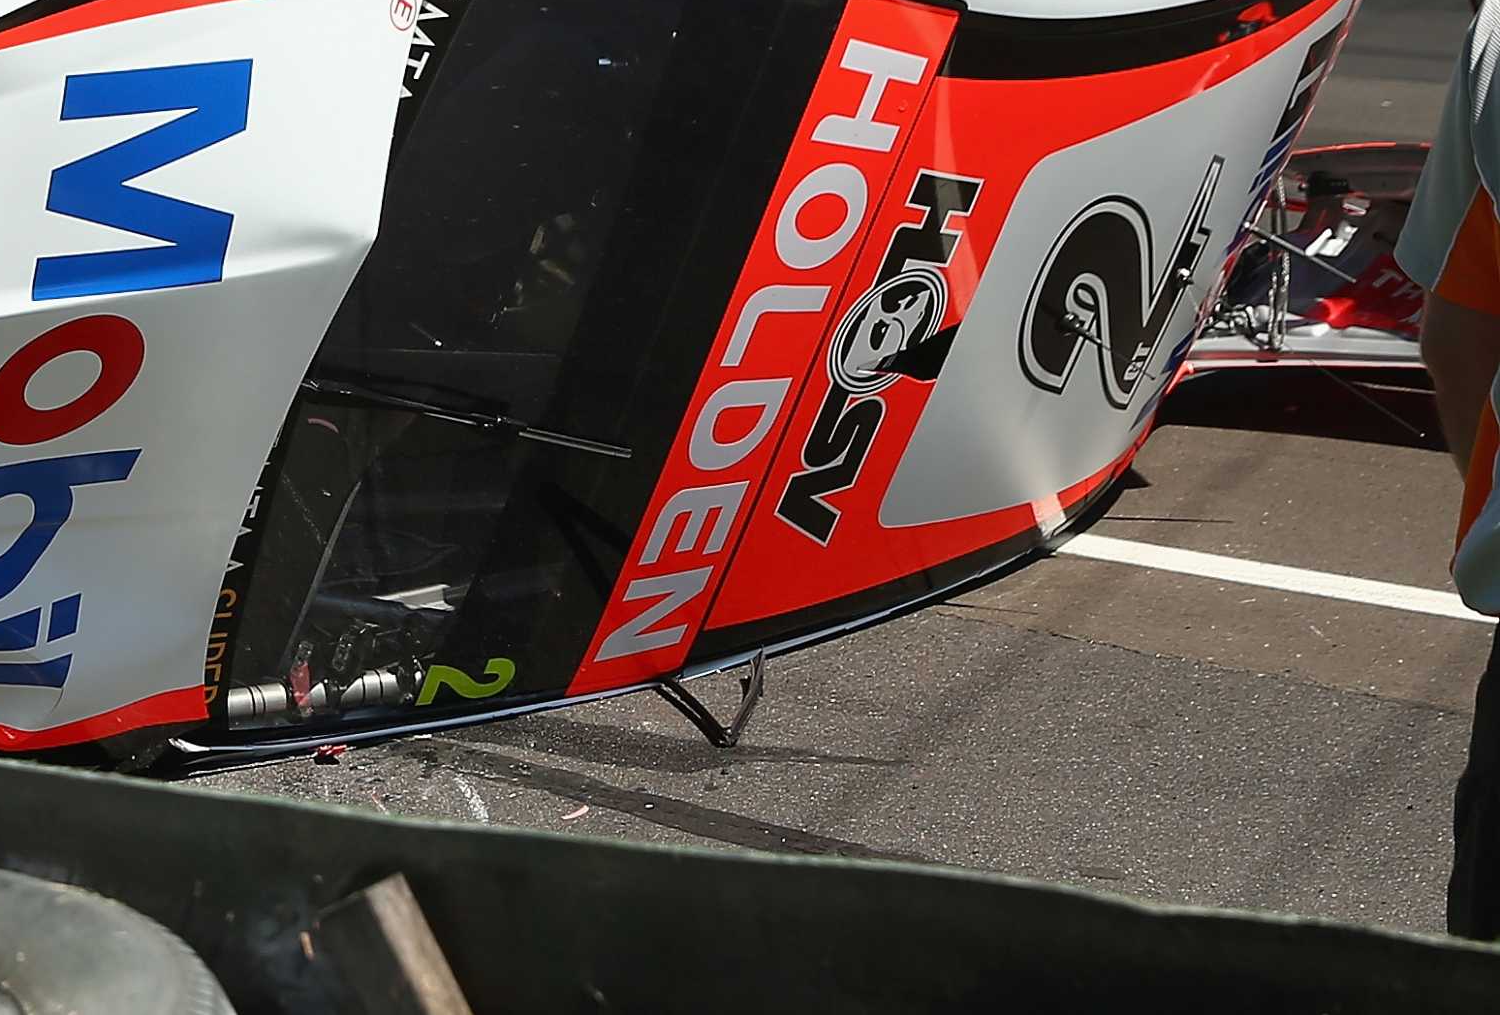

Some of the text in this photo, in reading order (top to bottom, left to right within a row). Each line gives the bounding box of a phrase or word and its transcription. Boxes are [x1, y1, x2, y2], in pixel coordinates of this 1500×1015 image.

[593, 37, 928, 663] HOLDEN
[1017, 154, 1225, 410] 2
[414, 657, 517, 707] 2
